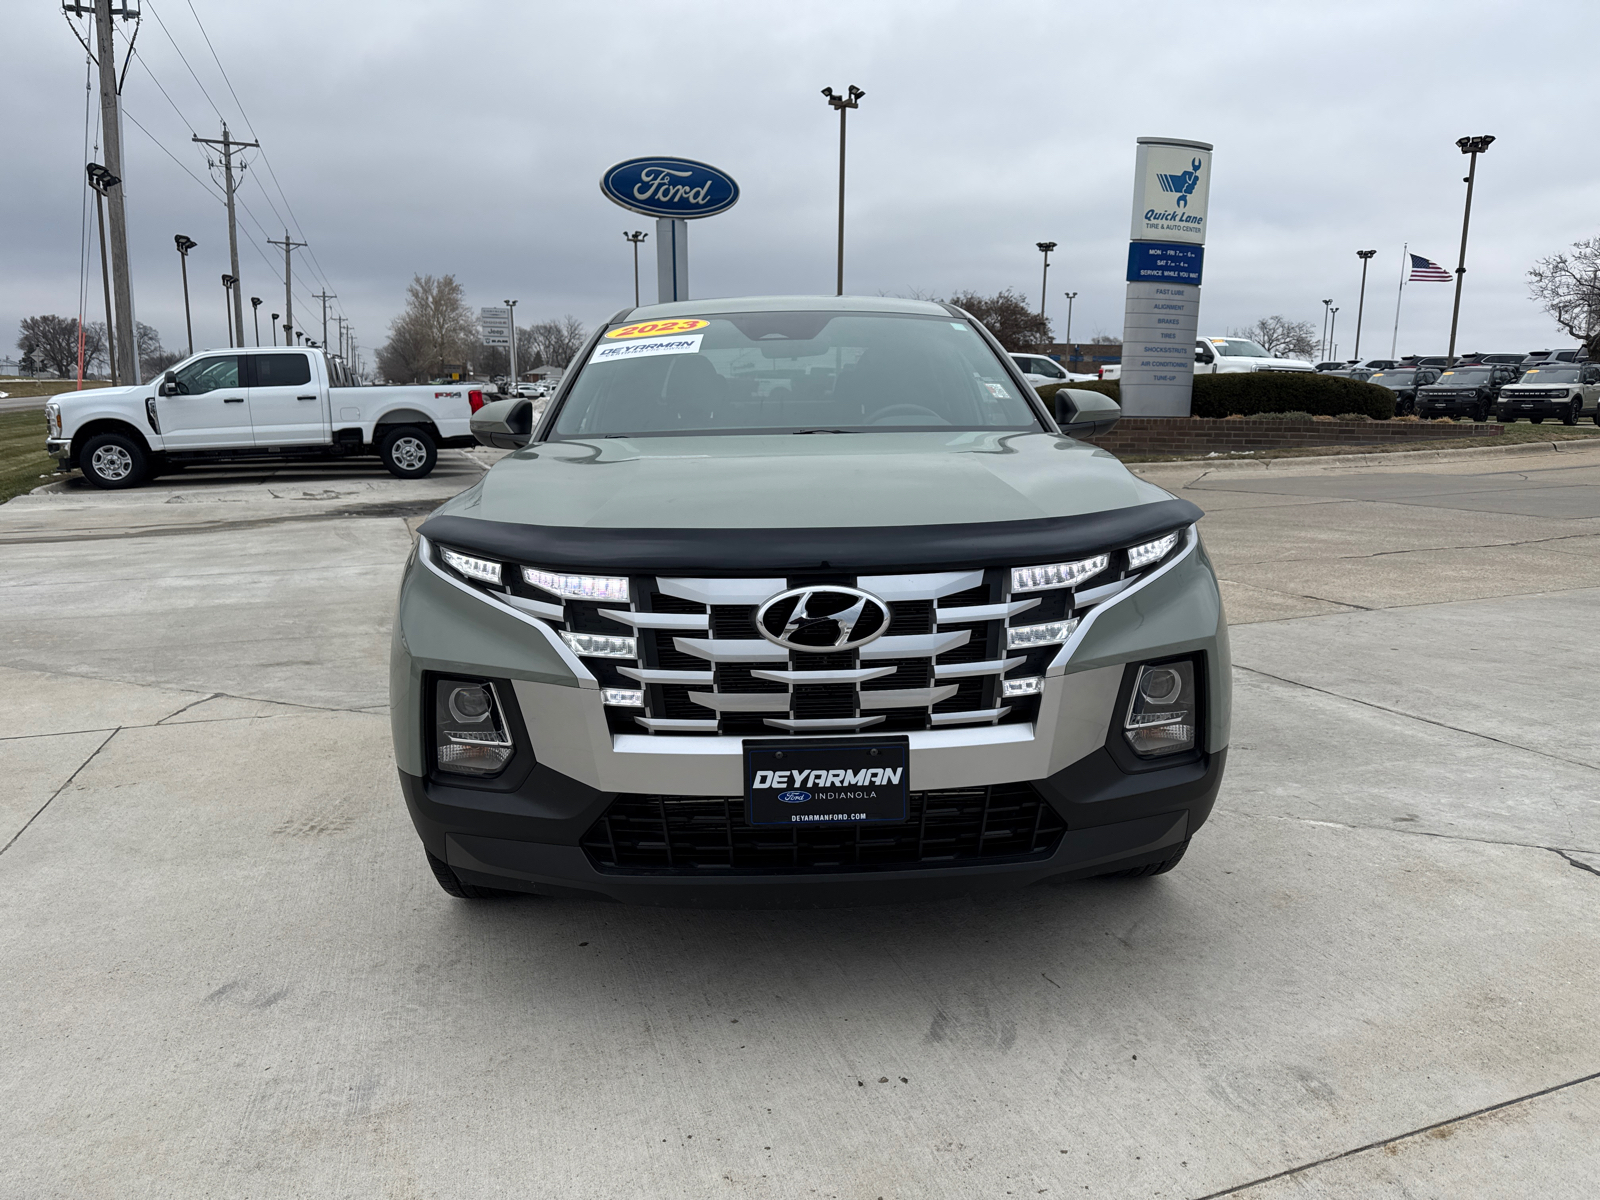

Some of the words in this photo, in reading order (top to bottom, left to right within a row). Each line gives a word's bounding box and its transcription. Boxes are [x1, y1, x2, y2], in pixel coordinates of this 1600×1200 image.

[633, 167, 712, 205] Ford
[1144, 209, 1179, 222] Quick
[1179, 212, 1203, 225] Lane
[615, 320, 700, 337] 2023
[600, 340, 695, 356] DEYARMAN
[605, 348, 644, 358] CERTIFIED
[752, 767, 903, 789] DEYARMAN
[784, 792, 805, 801] Ford
[815, 791, 877, 800] INDIANOLA
[792, 813, 866, 822] DEYARMANFORD.COM
